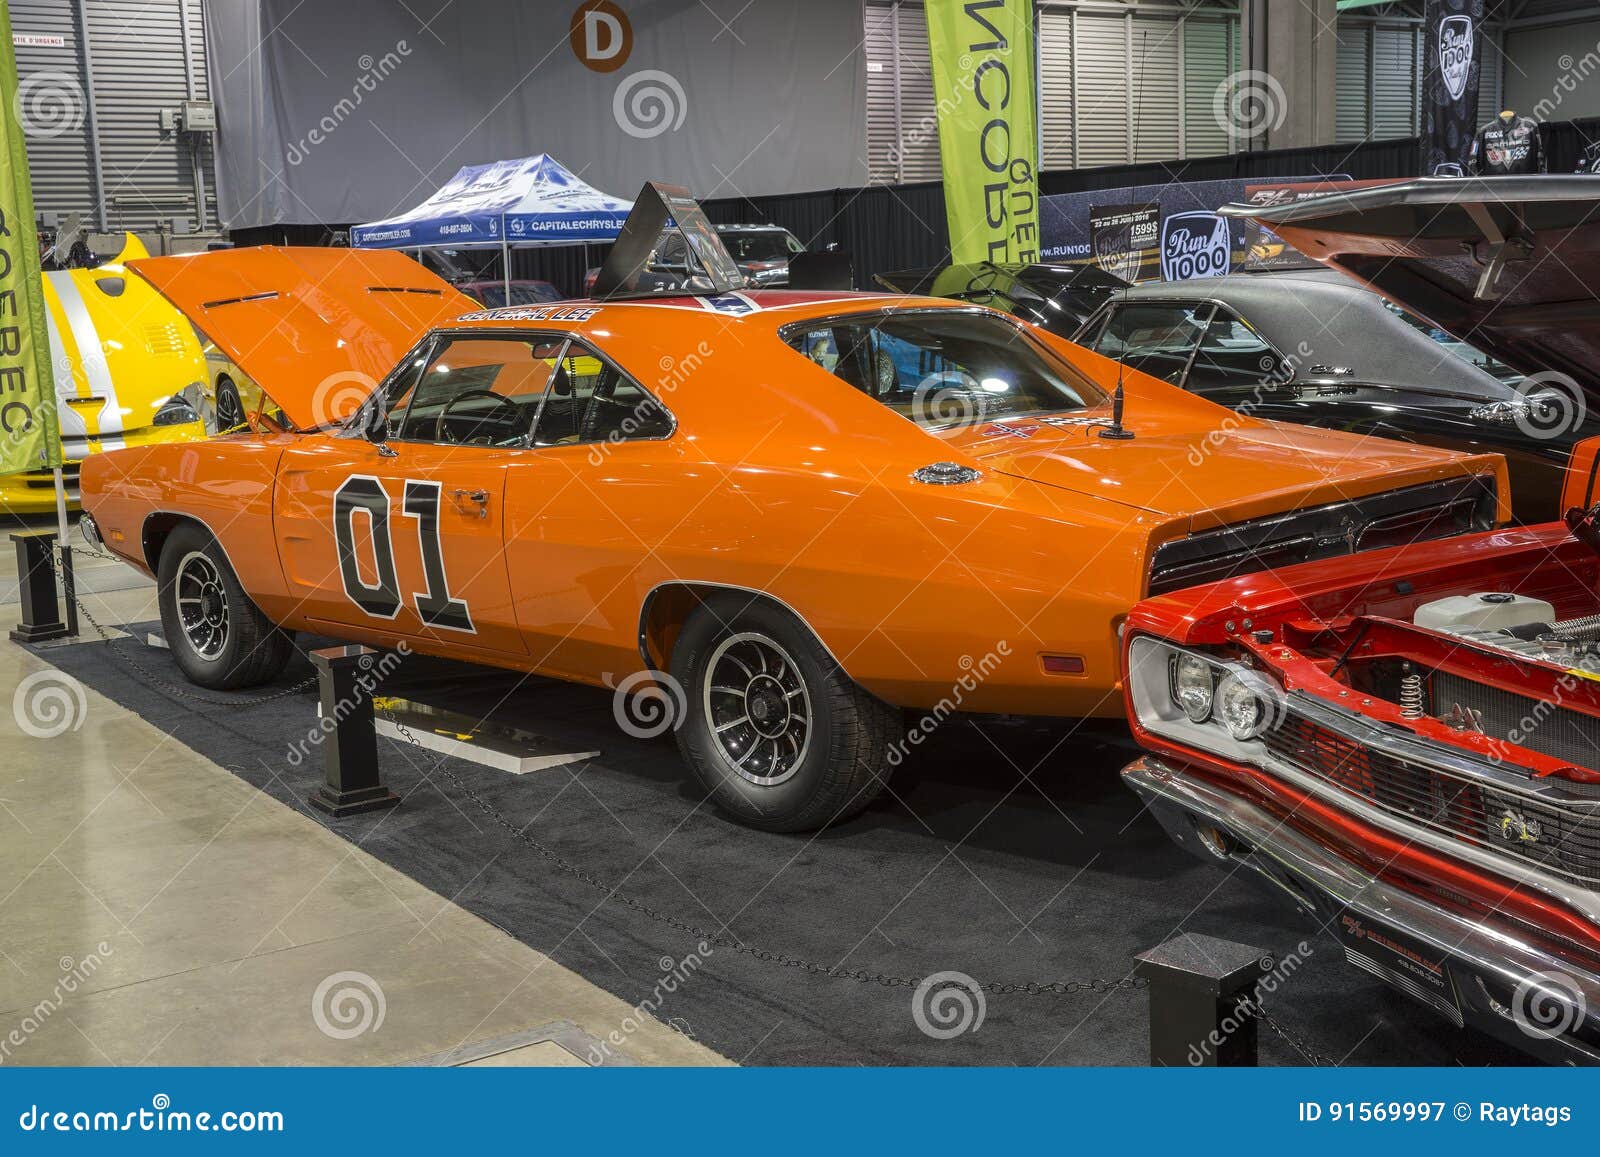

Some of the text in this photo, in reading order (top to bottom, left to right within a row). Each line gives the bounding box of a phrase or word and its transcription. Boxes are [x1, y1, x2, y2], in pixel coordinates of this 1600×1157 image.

[585, 11, 624, 60] D
[1131, 221, 1158, 236] 1599$
[1167, 228, 1208, 258] Run
[1168, 246, 1226, 281] 1000
[457, 307, 604, 322] GENERAL LEE
[333, 473, 477, 634] 01
